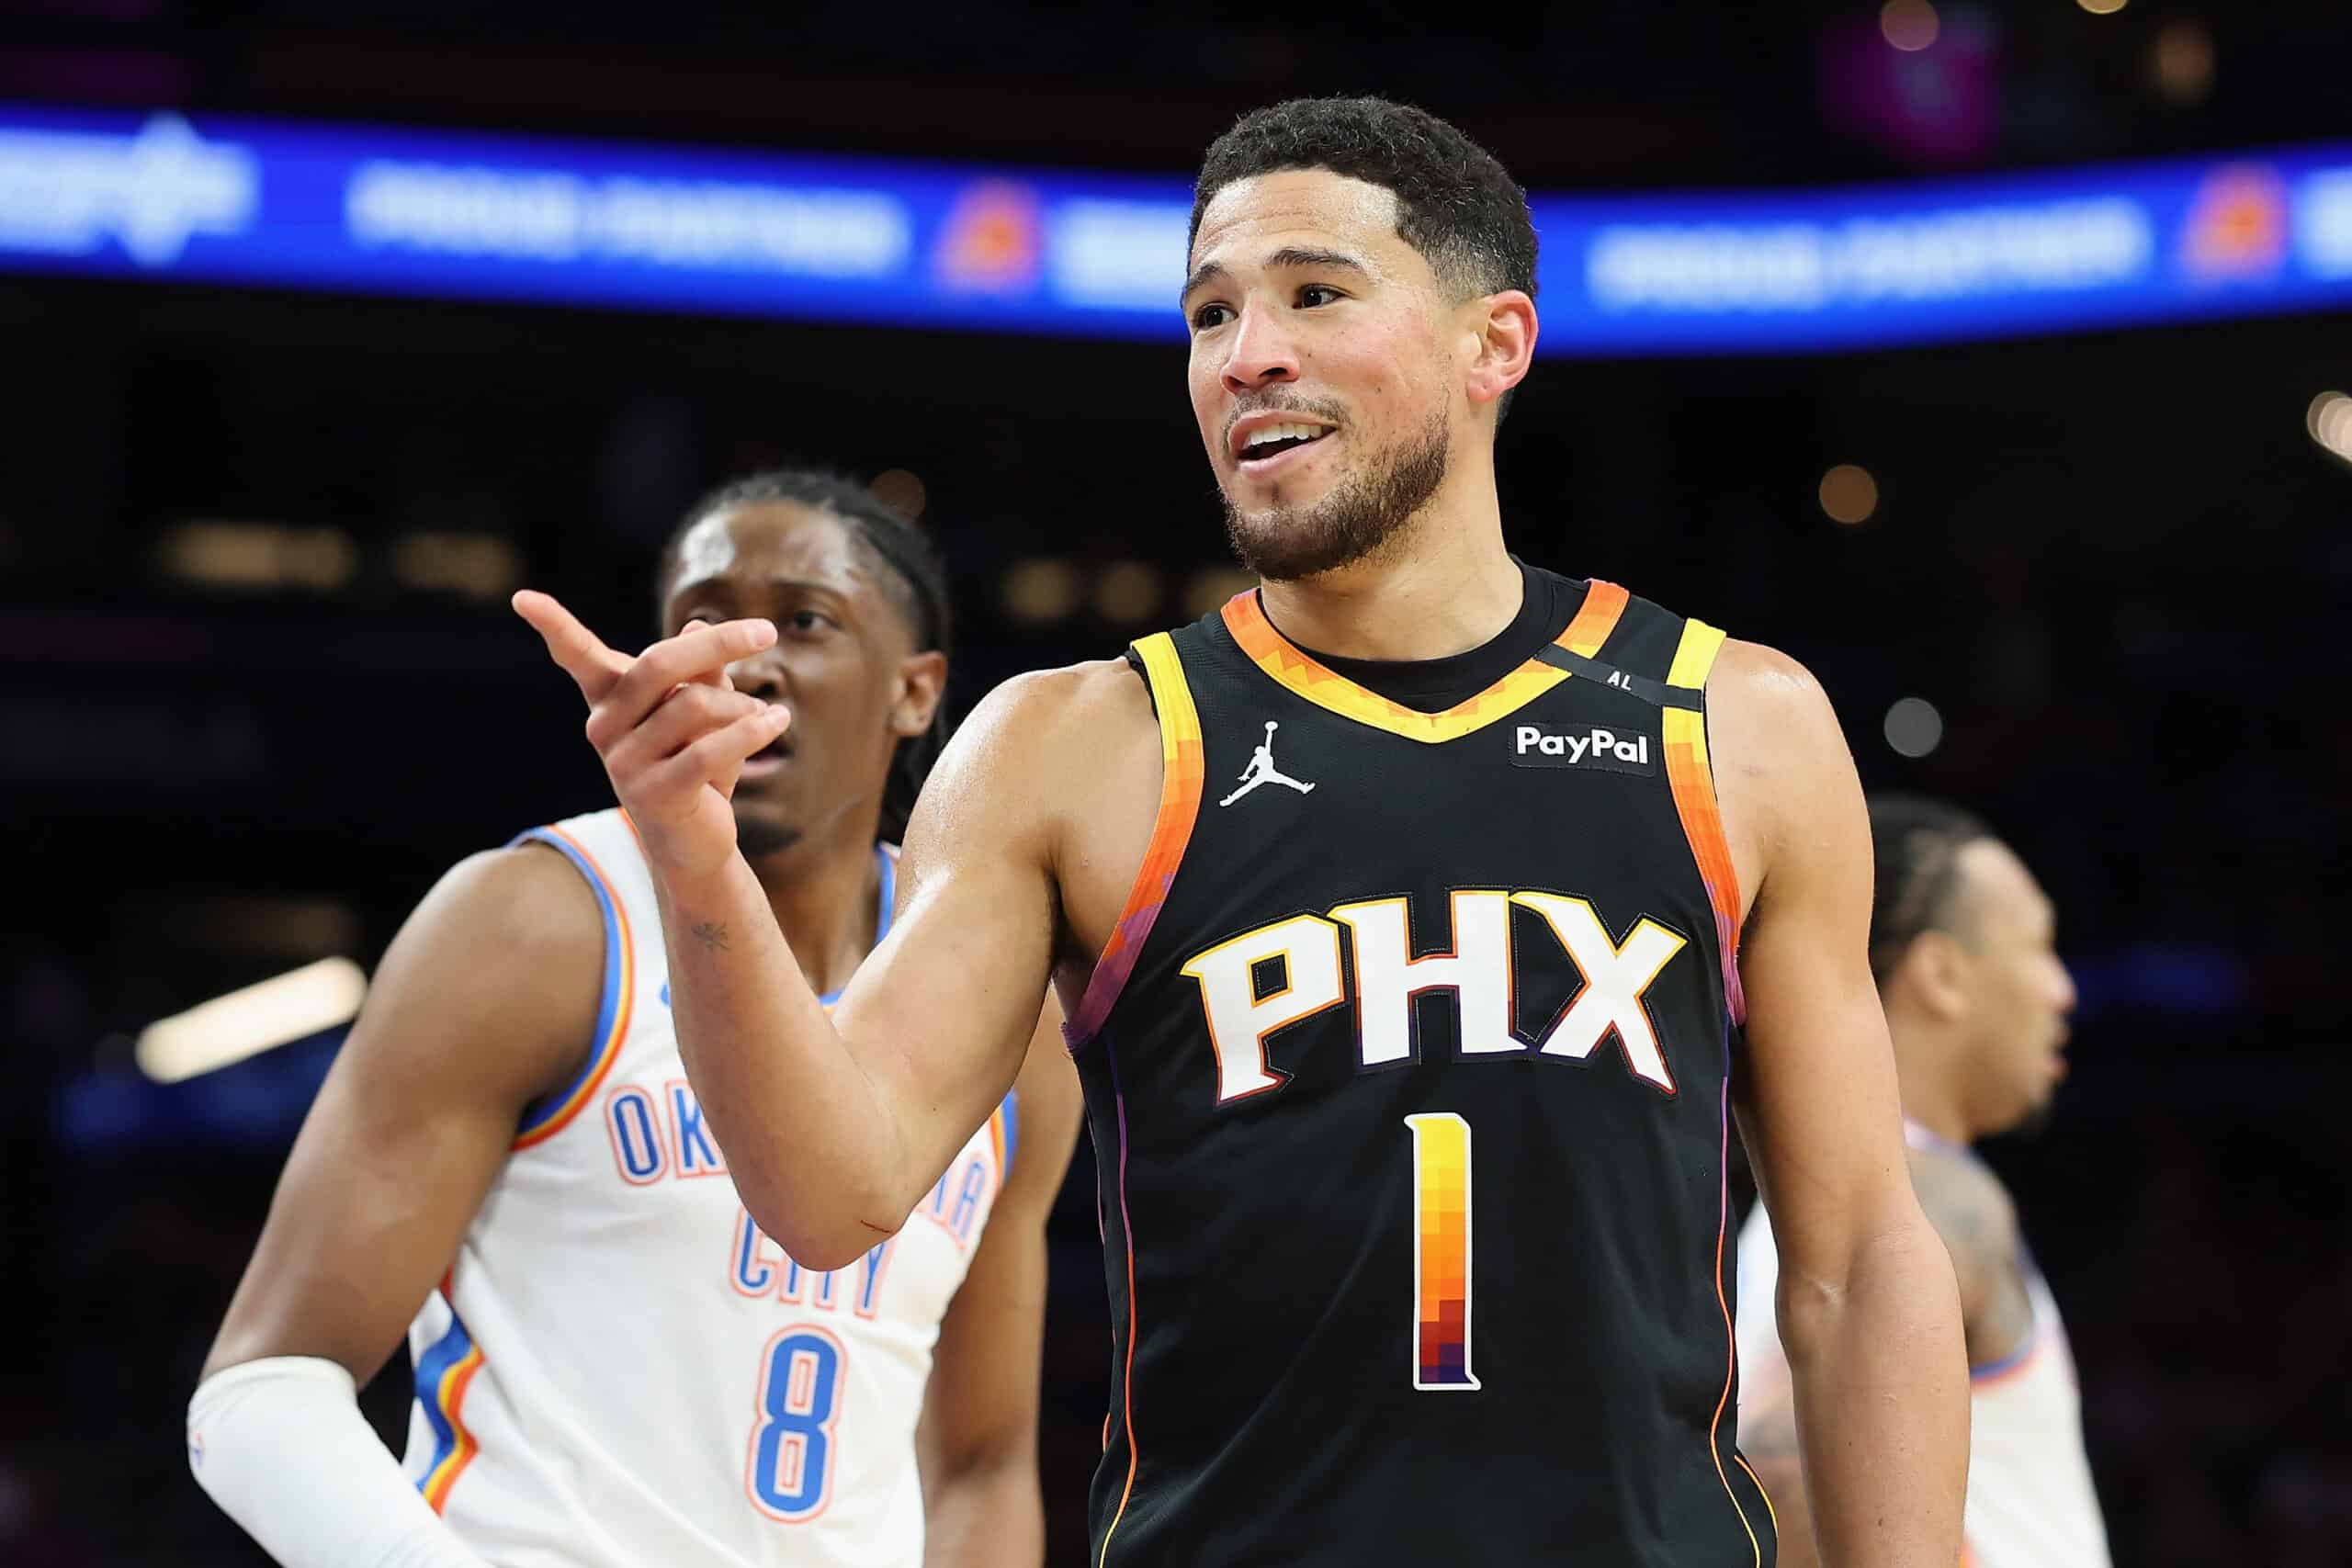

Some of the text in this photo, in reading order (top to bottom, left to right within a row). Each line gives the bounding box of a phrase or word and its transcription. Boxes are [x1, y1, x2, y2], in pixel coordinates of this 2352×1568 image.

[1516, 726, 1648, 764] PayPal
[1607, 671, 1632, 691] AL
[1180, 890, 1689, 1103] PHX
[1404, 1112, 1481, 1391] 1
[745, 1324, 849, 1524] 8
